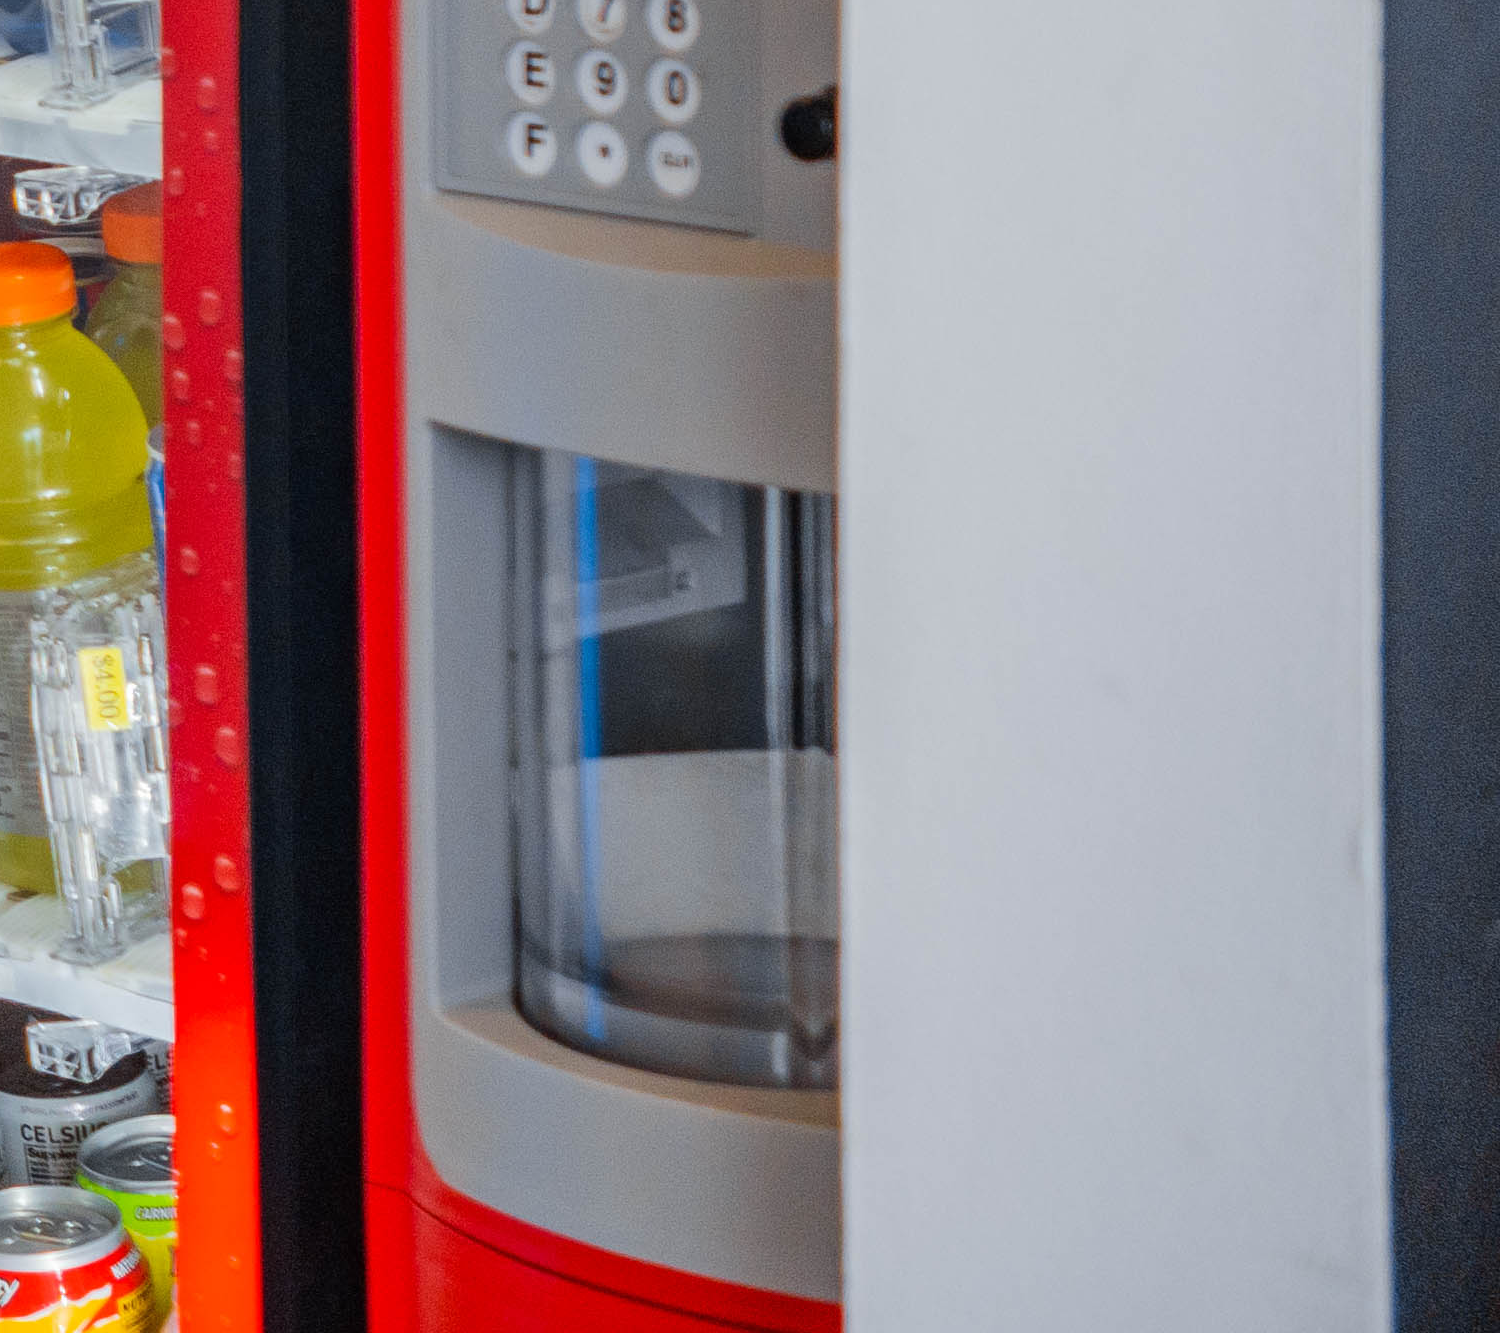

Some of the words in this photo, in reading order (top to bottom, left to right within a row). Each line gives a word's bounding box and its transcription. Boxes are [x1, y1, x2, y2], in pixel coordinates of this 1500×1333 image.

[524, 51, 547, 88] E
[596, 60, 615, 96] 9
[667, 69, 686, 105] 0
[525, 123, 547, 158] F
[94, 655, 121, 722] $4.00
